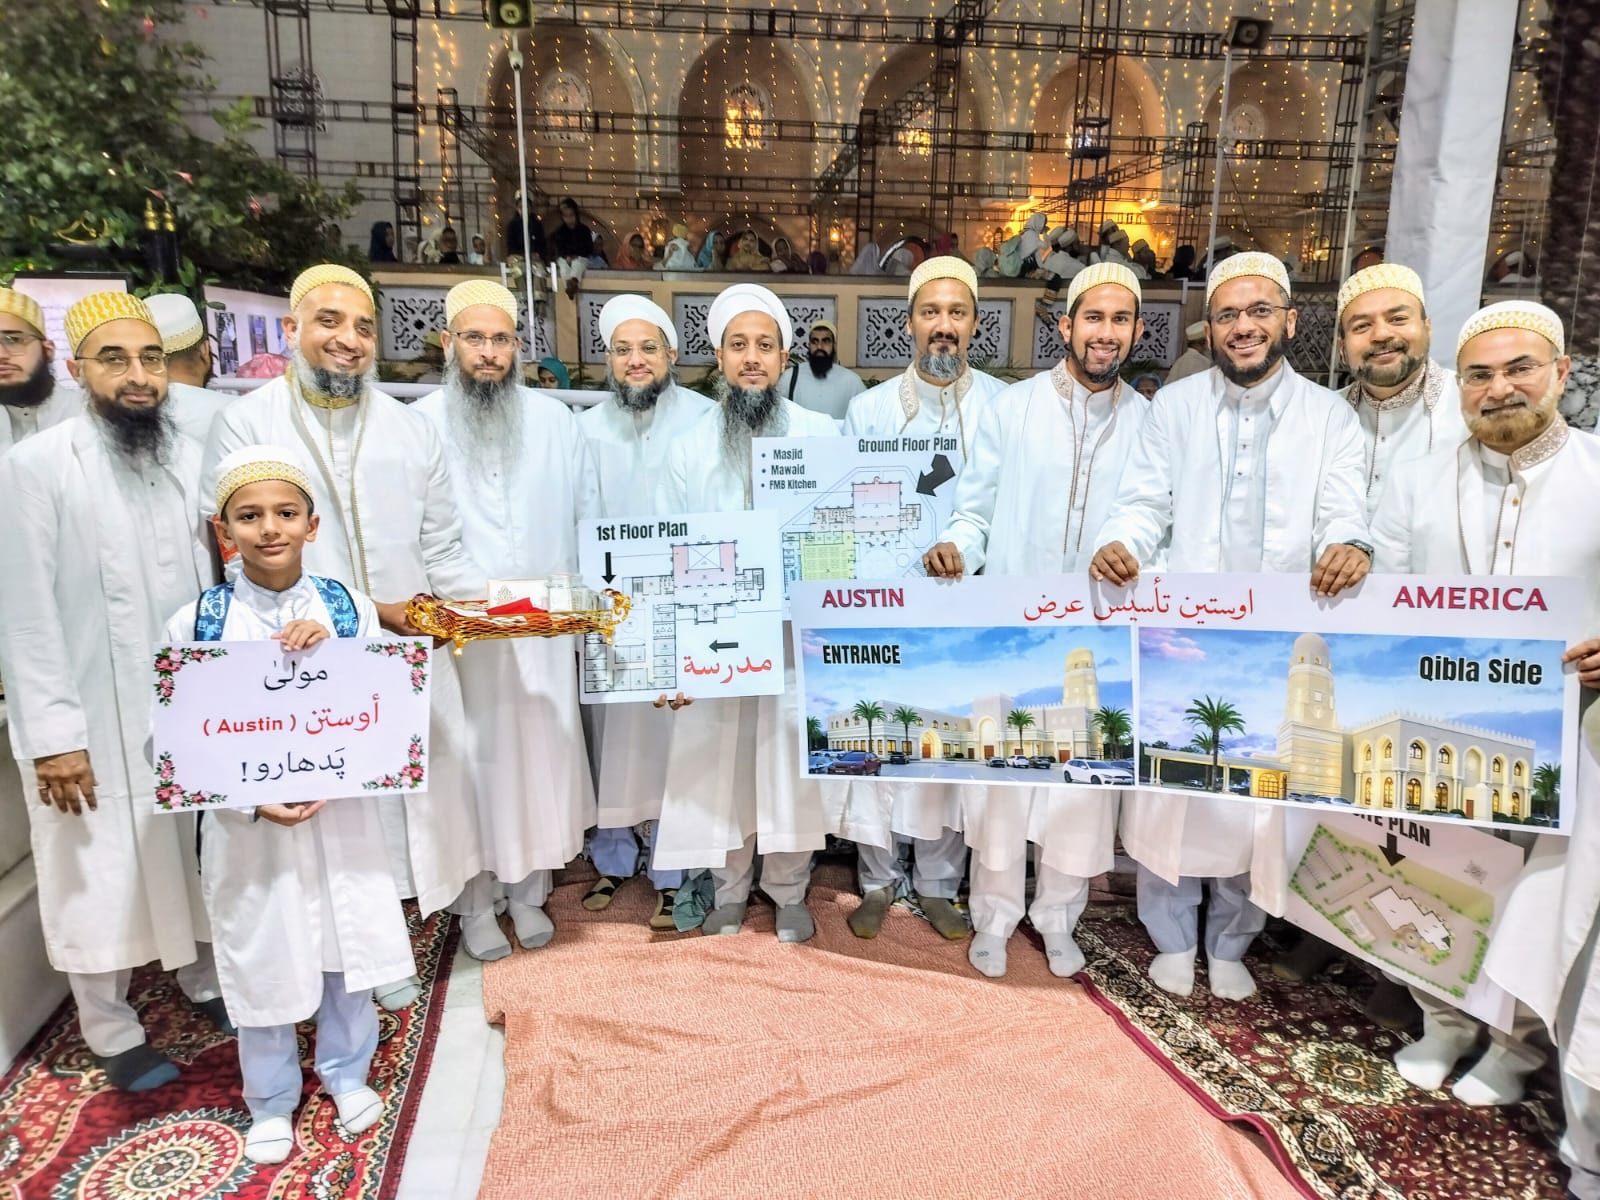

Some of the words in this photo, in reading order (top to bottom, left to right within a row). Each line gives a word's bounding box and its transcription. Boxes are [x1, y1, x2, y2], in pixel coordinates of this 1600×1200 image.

[773, 448, 803, 461] Masjid
[858, 438, 899, 453] Ground
[902, 438, 931, 451] Floor
[933, 437, 957, 451] Plan
[770, 480, 785, 490] FMB
[788, 480, 817, 489] Kitchen
[597, 525, 616, 541] 1st
[619, 523, 655, 540] Floor
[658, 521, 688, 538] Plan
[822, 589, 904, 608] AUSTIN
[1023, 595, 1084, 621] عرض
[1393, 586, 1547, 611] AMERICA
[823, 645, 900, 663] ENTRANCE
[685, 657, 771, 682] مدرسة
[1420, 656, 1479, 681] Qibla
[1489, 659, 1541, 684] Side
[1389, 817, 1430, 847] PLAN
